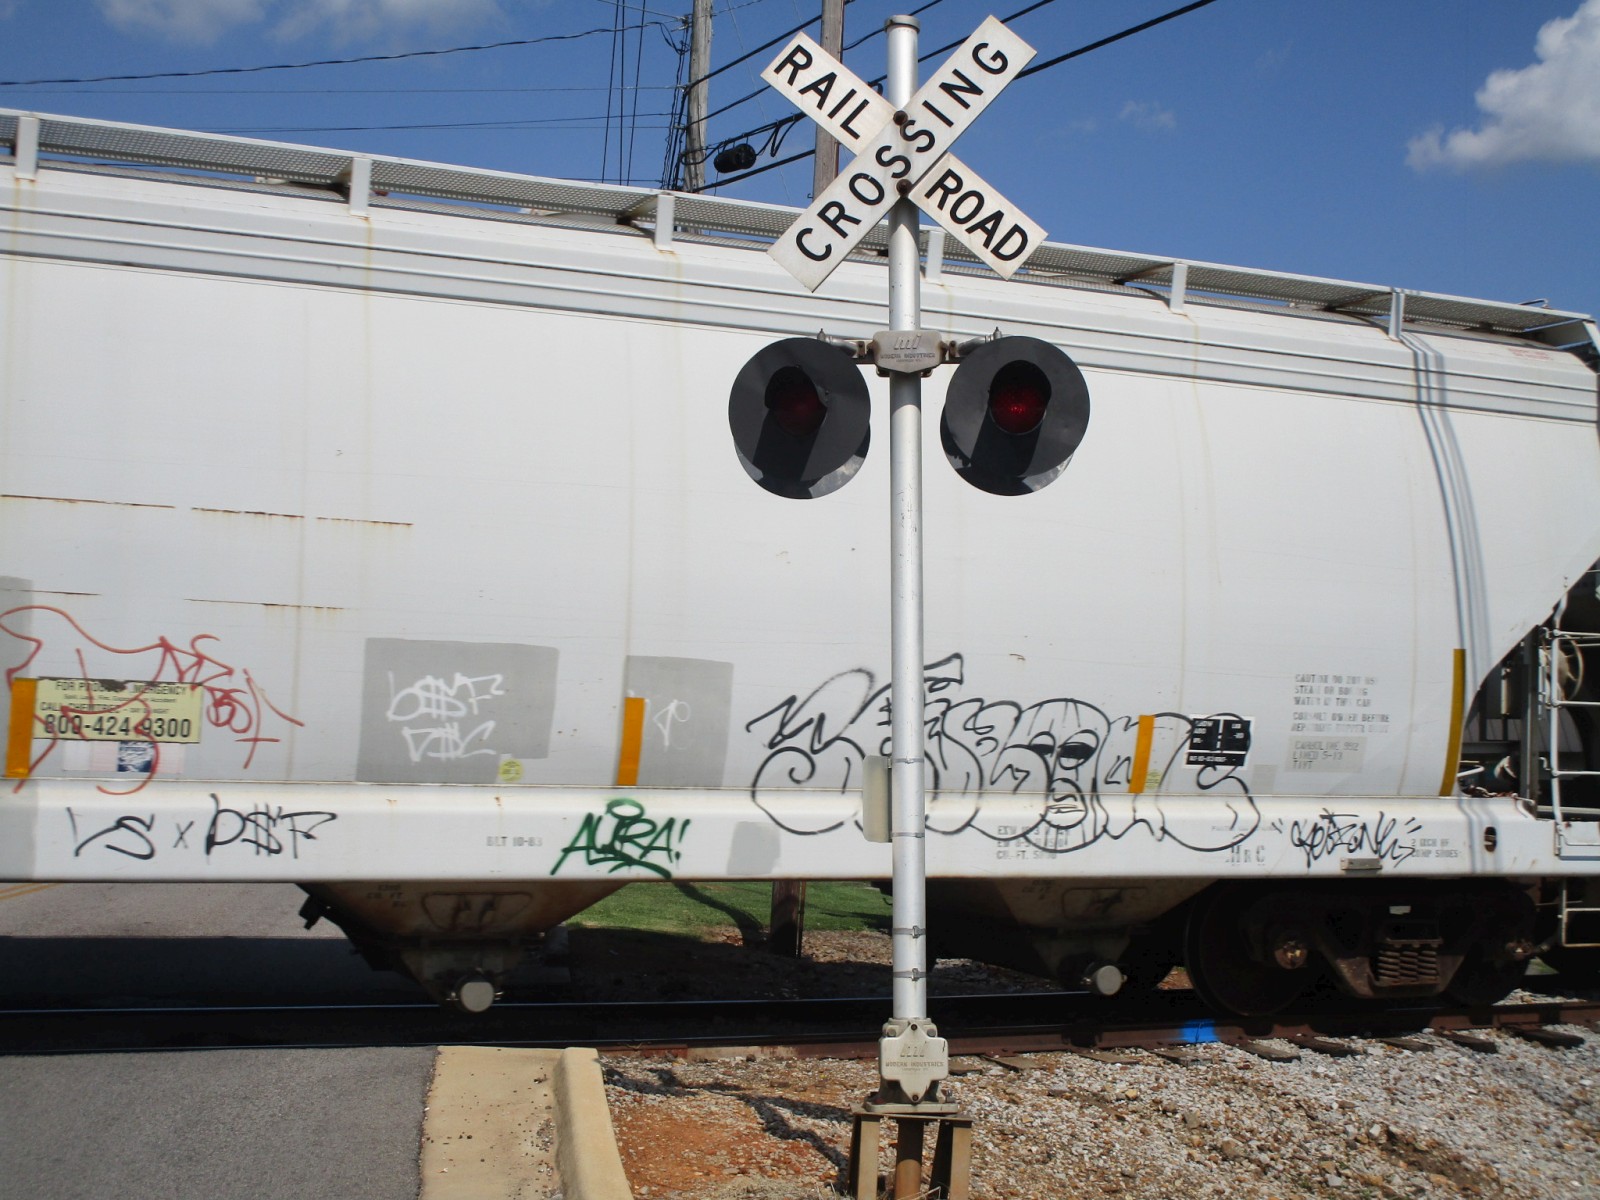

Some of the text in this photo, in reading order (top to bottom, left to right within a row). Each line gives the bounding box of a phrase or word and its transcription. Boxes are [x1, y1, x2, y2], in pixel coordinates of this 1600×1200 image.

[774, 44, 870, 139] RAIL
[796, 43, 1009, 262] CROSSING
[925, 169, 1029, 261] ROAD
[44, 714, 191, 738] 800-4249300
[56, 681, 76, 691] FOR
